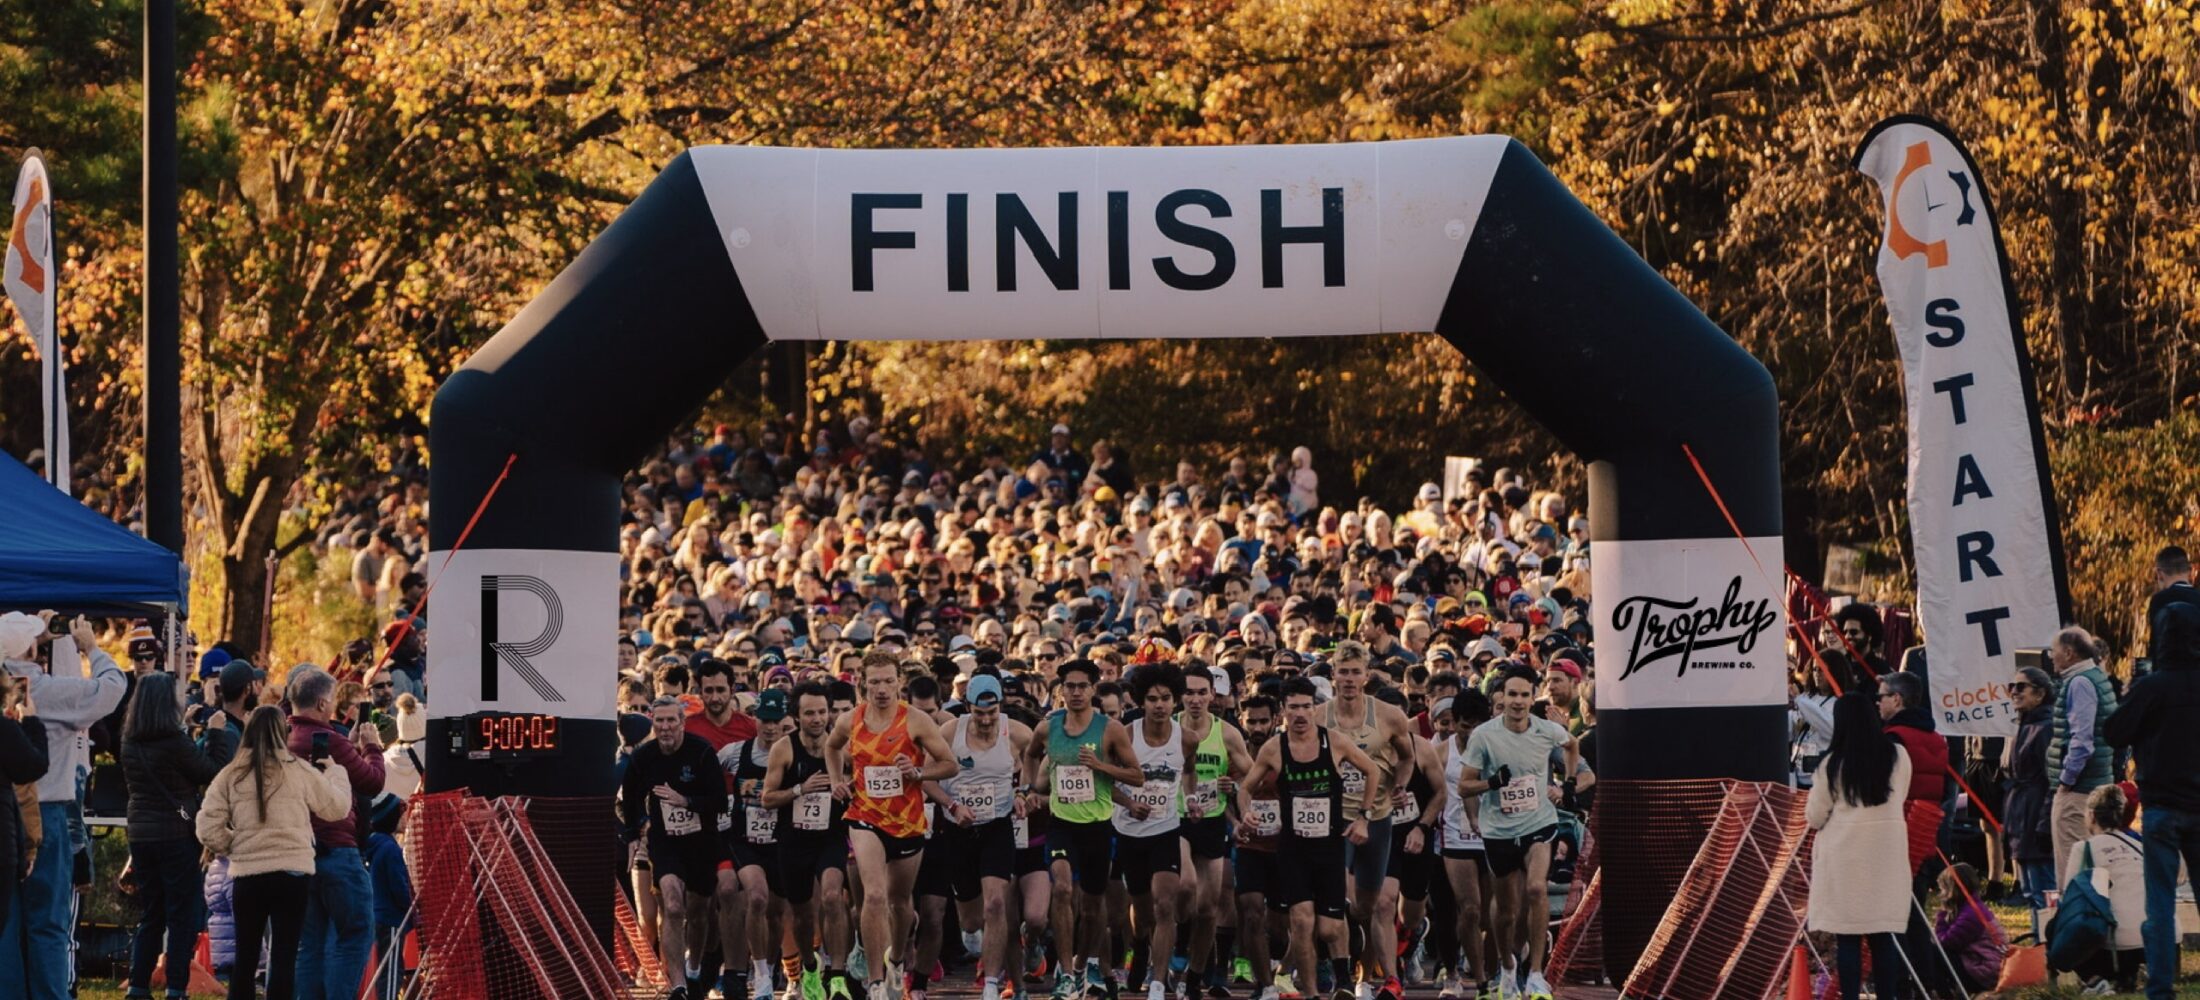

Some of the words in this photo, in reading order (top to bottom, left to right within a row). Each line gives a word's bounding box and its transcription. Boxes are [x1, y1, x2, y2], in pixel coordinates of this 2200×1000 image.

[851, 187, 1346, 292] FINISH
[1925, 298, 2010, 658] START
[1612, 575, 1777, 681] Trophy
[481, 575, 566, 702] R
[1691, 661, 1736, 669] BREWING
[1739, 661, 1755, 669] CO.
[1944, 706, 1994, 723] RACE
[867, 779, 900, 791] 1523
[1060, 778, 1090, 790] 1081
[1133, 794, 1167, 806] 1080
[1502, 787, 1536, 801] 1538
[961, 795, 993, 807] 1690
[668, 811, 694, 823] 439
[803, 805, 821, 817] 73
[1297, 811, 1325, 824] 280
